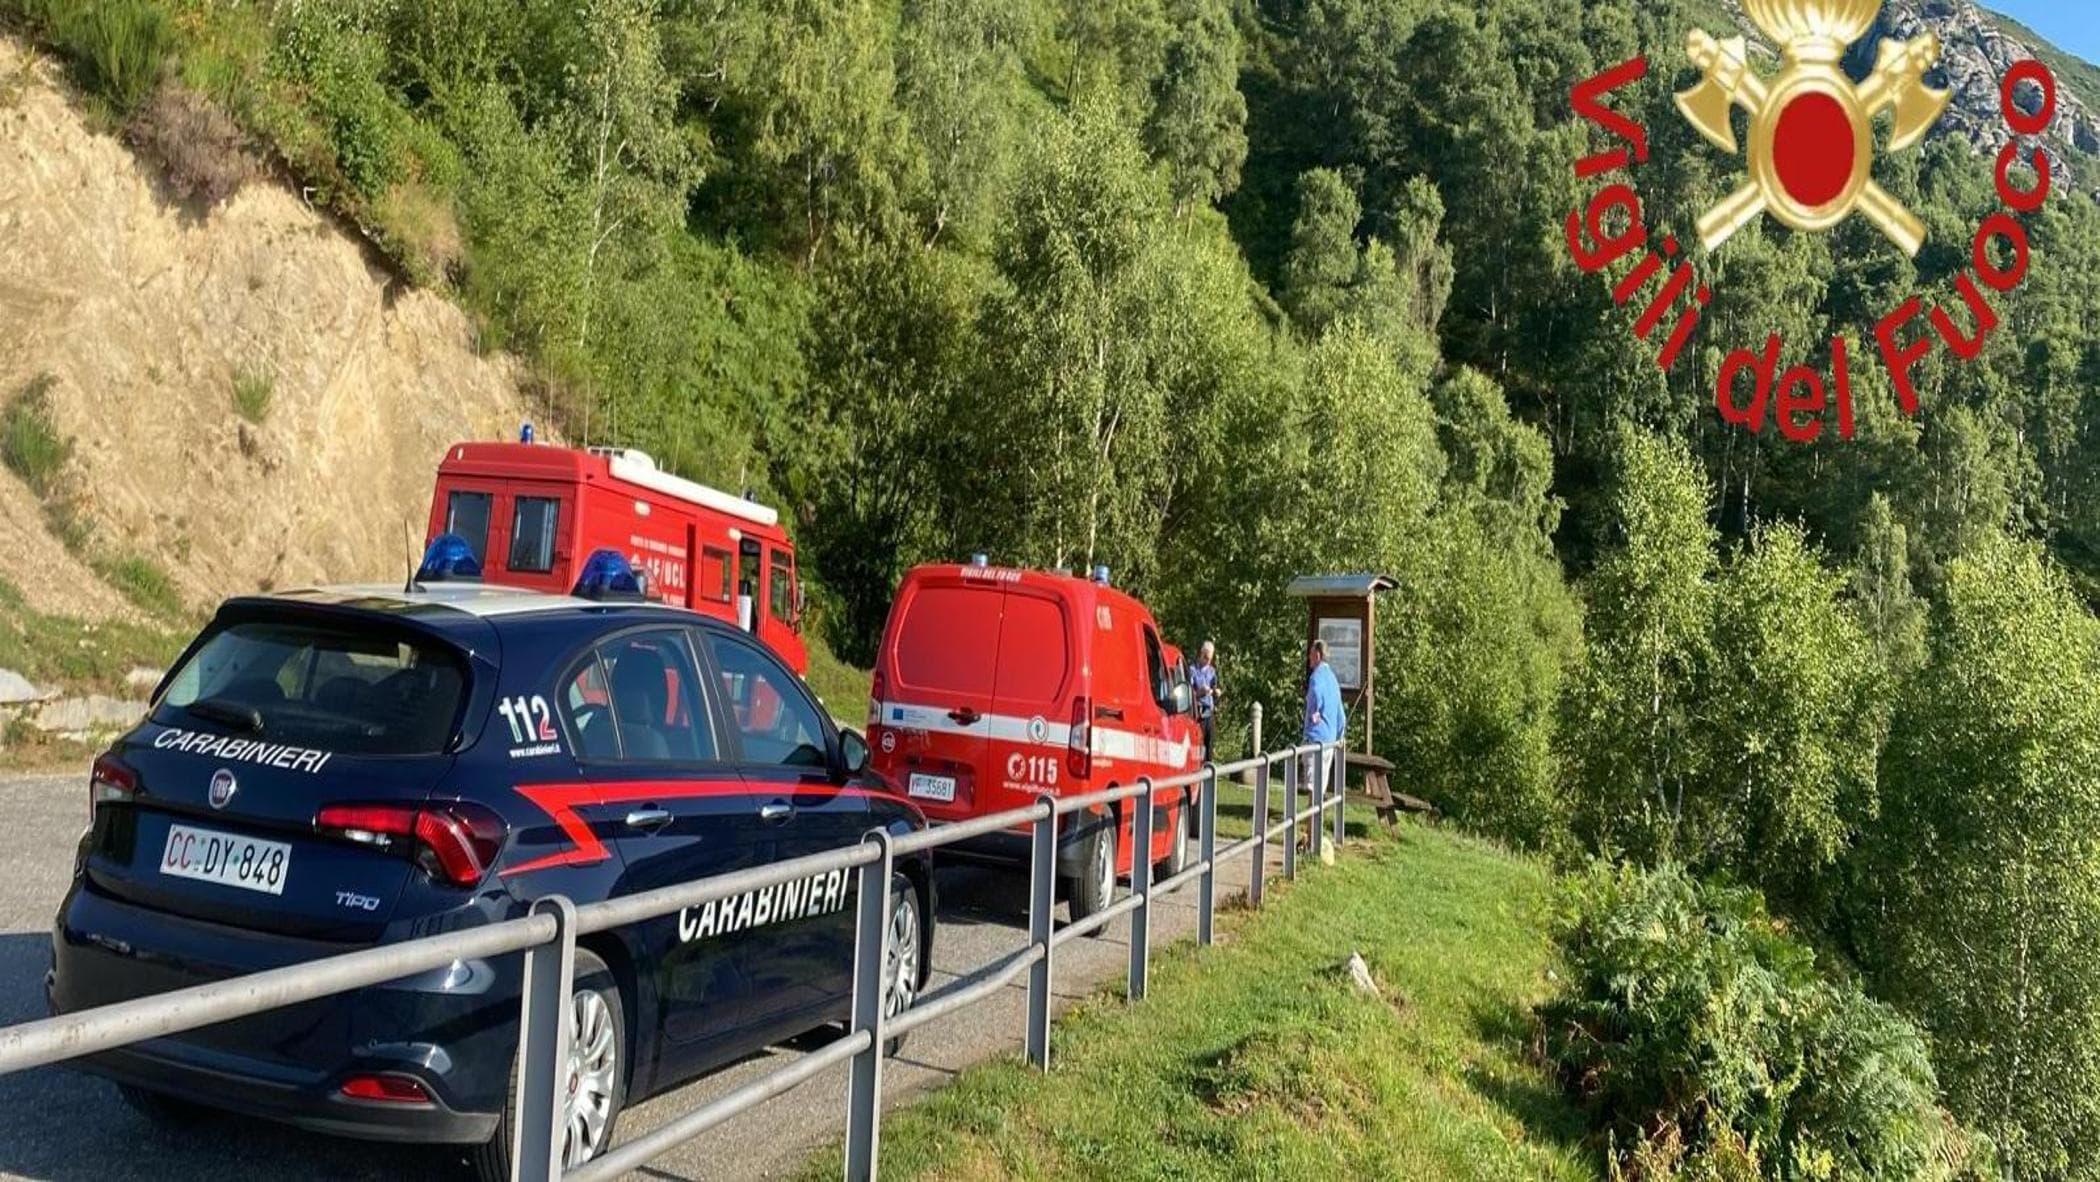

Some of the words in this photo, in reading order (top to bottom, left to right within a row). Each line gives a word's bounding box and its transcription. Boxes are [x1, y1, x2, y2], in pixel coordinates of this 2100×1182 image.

[498, 694, 558, 742] 112
[153, 730, 332, 774] CARABINIERI
[1028, 755, 1058, 784] 115
[167, 831, 196, 869] CC
[203, 837, 235, 878] DY
[238, 844, 285, 887] 848
[679, 867, 850, 943] CARABINIERI
